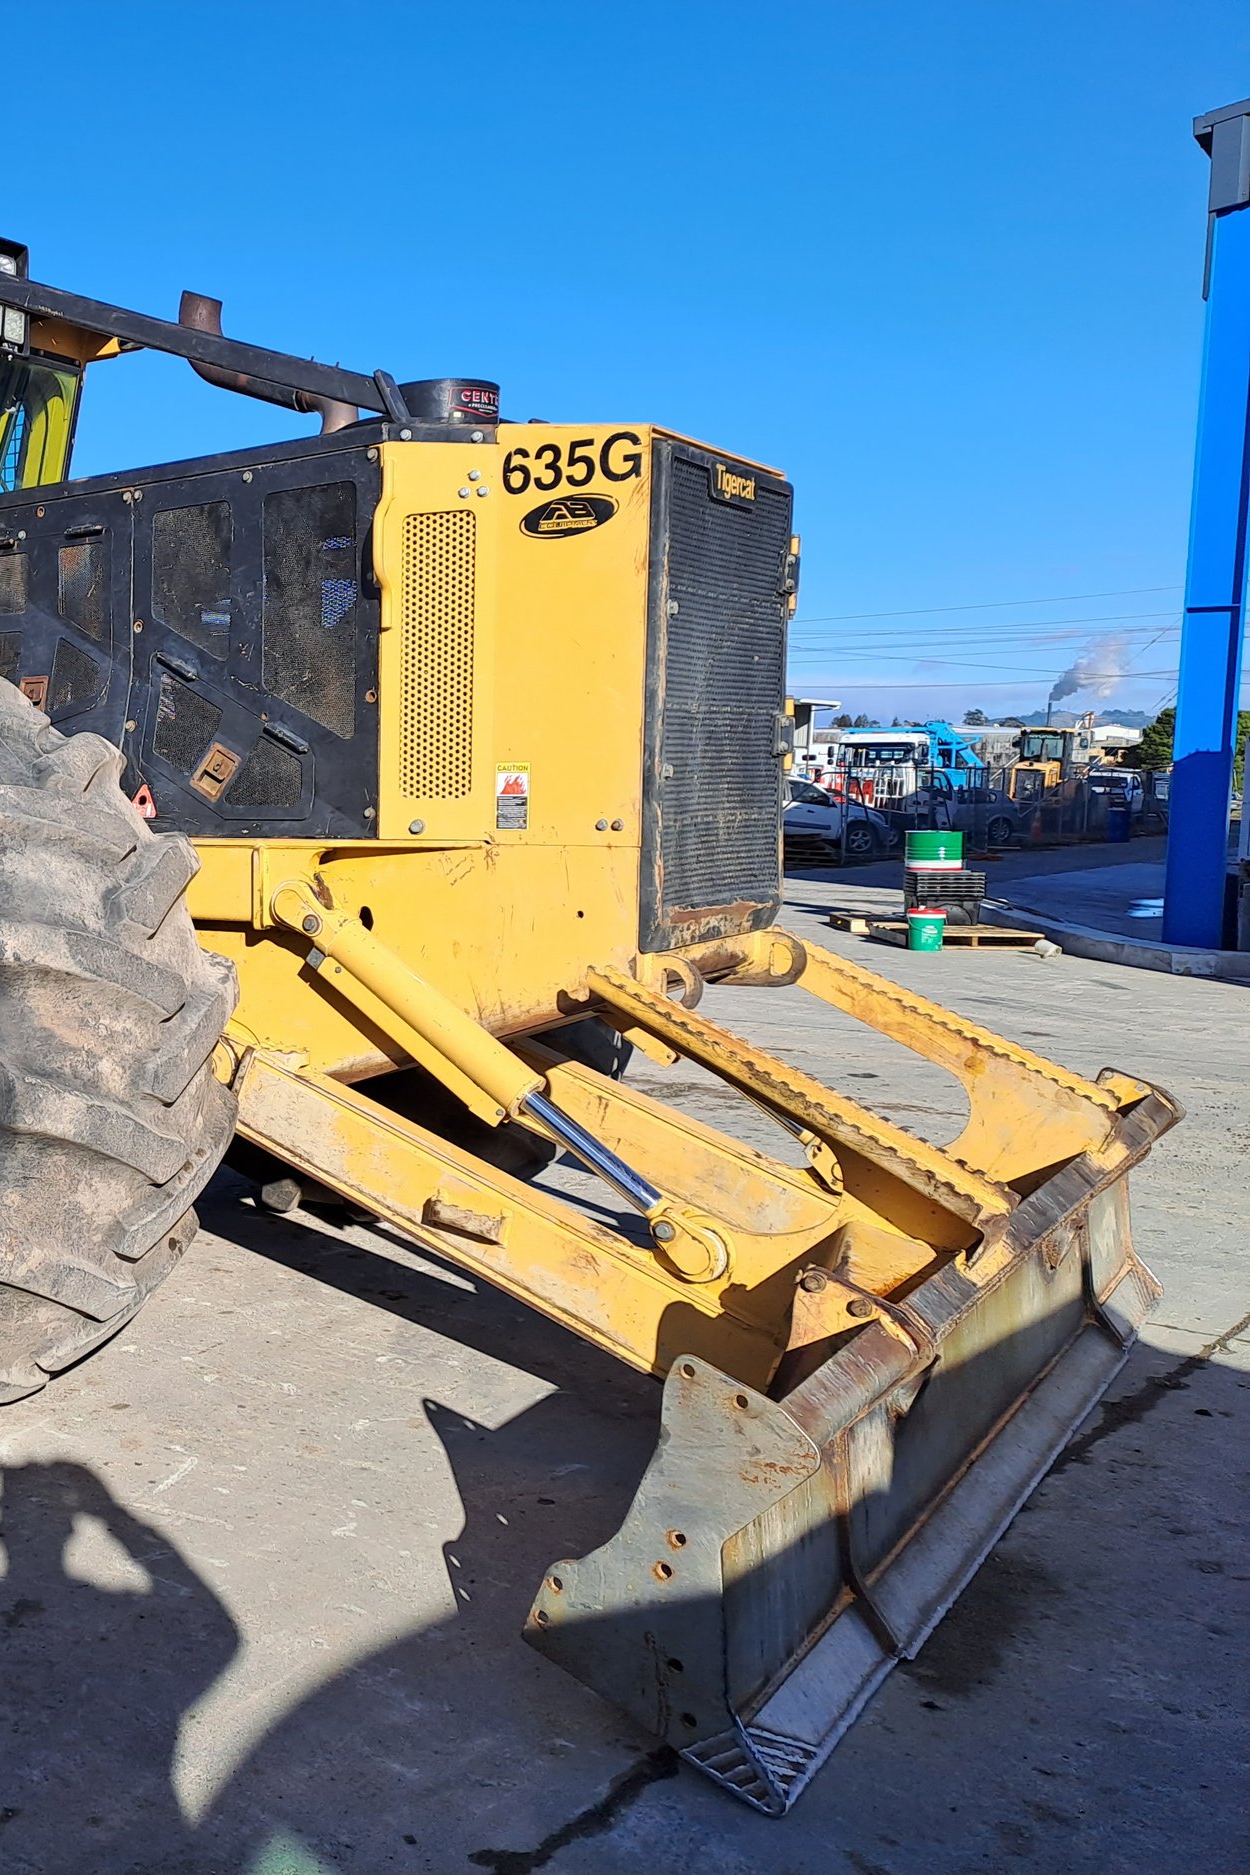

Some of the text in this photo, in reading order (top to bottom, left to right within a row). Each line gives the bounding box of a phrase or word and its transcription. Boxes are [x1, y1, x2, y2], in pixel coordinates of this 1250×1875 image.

[503, 431, 642, 495] 635G
[715, 463, 756, 501] Tigercat
[497, 764, 529, 772] CAUTION
